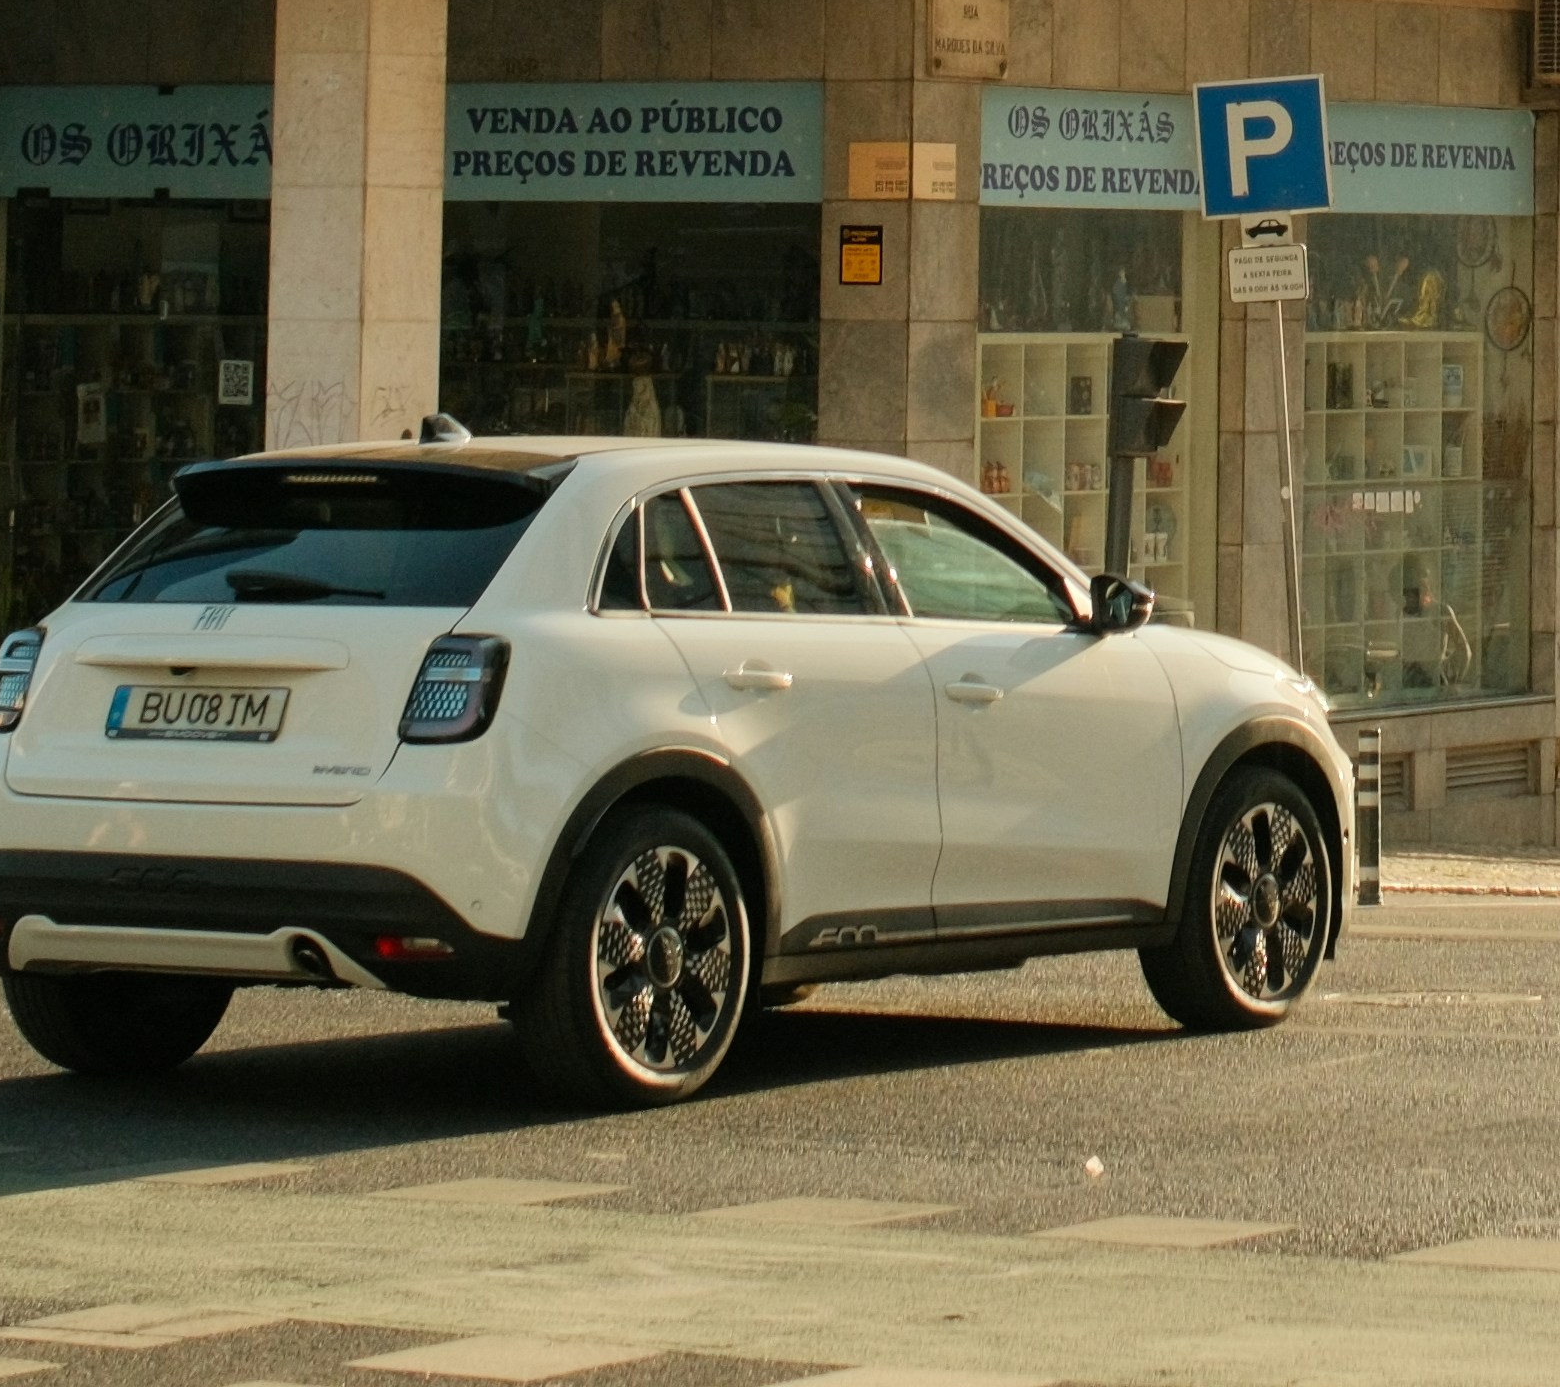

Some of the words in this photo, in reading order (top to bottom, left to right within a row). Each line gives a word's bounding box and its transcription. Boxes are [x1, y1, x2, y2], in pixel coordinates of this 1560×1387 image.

[467, 106, 579, 134] VENDA
[587, 106, 632, 134] AO
[640, 98, 783, 134] PÚBLICO
[1008, 105, 1051, 140] OS
[1058, 101, 1176, 144] ORIXÁS
[20, 122, 92, 166] OS
[107, 108, 273, 167] ORIXÁ
[1226, 99, 1293, 197] P
[453, 149, 576, 184] PREÇOS
[583, 149, 627, 177] DE
[635, 150, 795, 178] REVENDA
[1329, 141, 1386, 174] EÇOS
[1391, 142, 1418, 167] DE
[1421, 143, 1516, 170] REVENDA
[981, 162, 1060, 198] REÇOS
[1065, 165, 1097, 193] DE
[1250, 270, 1271, 279] SEXTA
[1272, 269, 1292, 277] FEIRA
[1254, 255, 1264, 264] DE
[192, 606, 237, 631] FIAT
[312, 764, 372, 777] HYBRID
